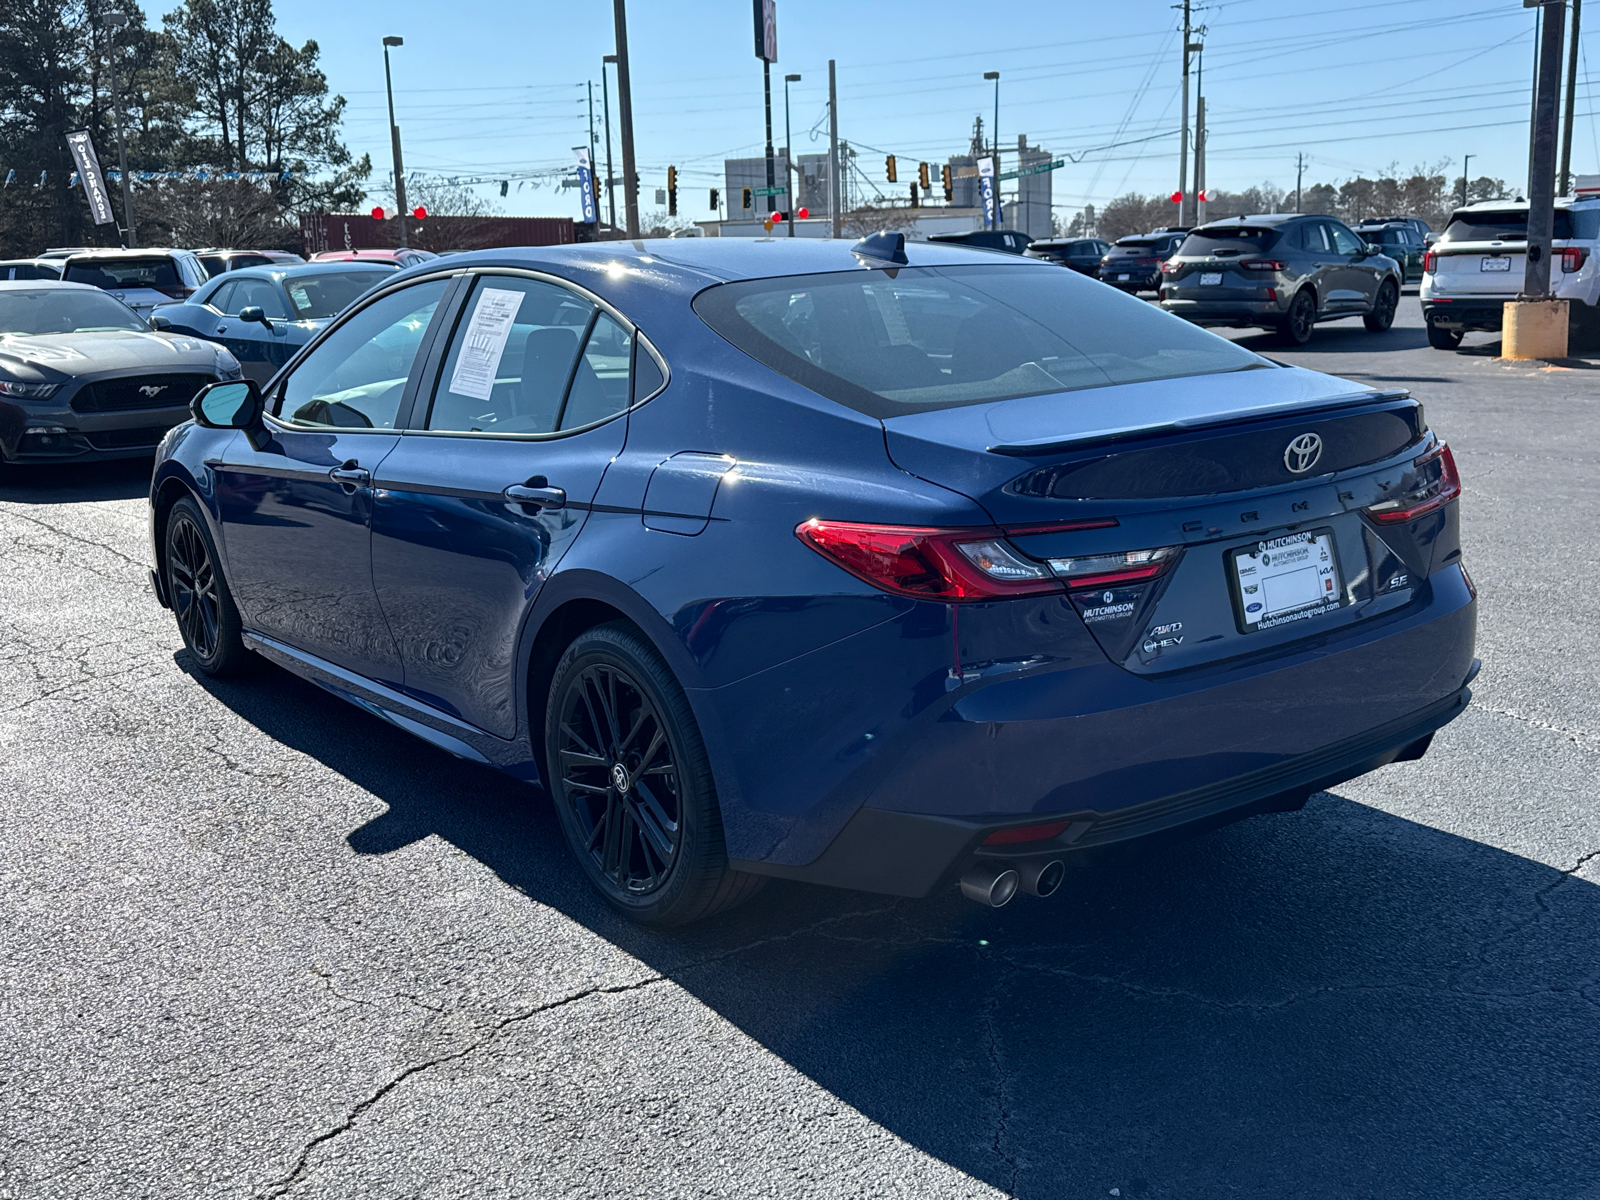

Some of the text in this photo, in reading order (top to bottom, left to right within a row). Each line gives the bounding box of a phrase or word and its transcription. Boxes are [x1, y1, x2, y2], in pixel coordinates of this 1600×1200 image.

[1267, 531, 1312, 551] HUTCHINSON
[1239, 566, 1256, 575] GMC
[1390, 574, 1408, 589] SE
[1083, 602, 1134, 618] HUTCHINSON
[1084, 610, 1132, 623] AUTOMOTIVE GROUP
[1257, 601, 1340, 630] Hutchinsonautogroup.com
[1149, 622, 1182, 637] AWD
[1153, 636, 1184, 648] HEV
